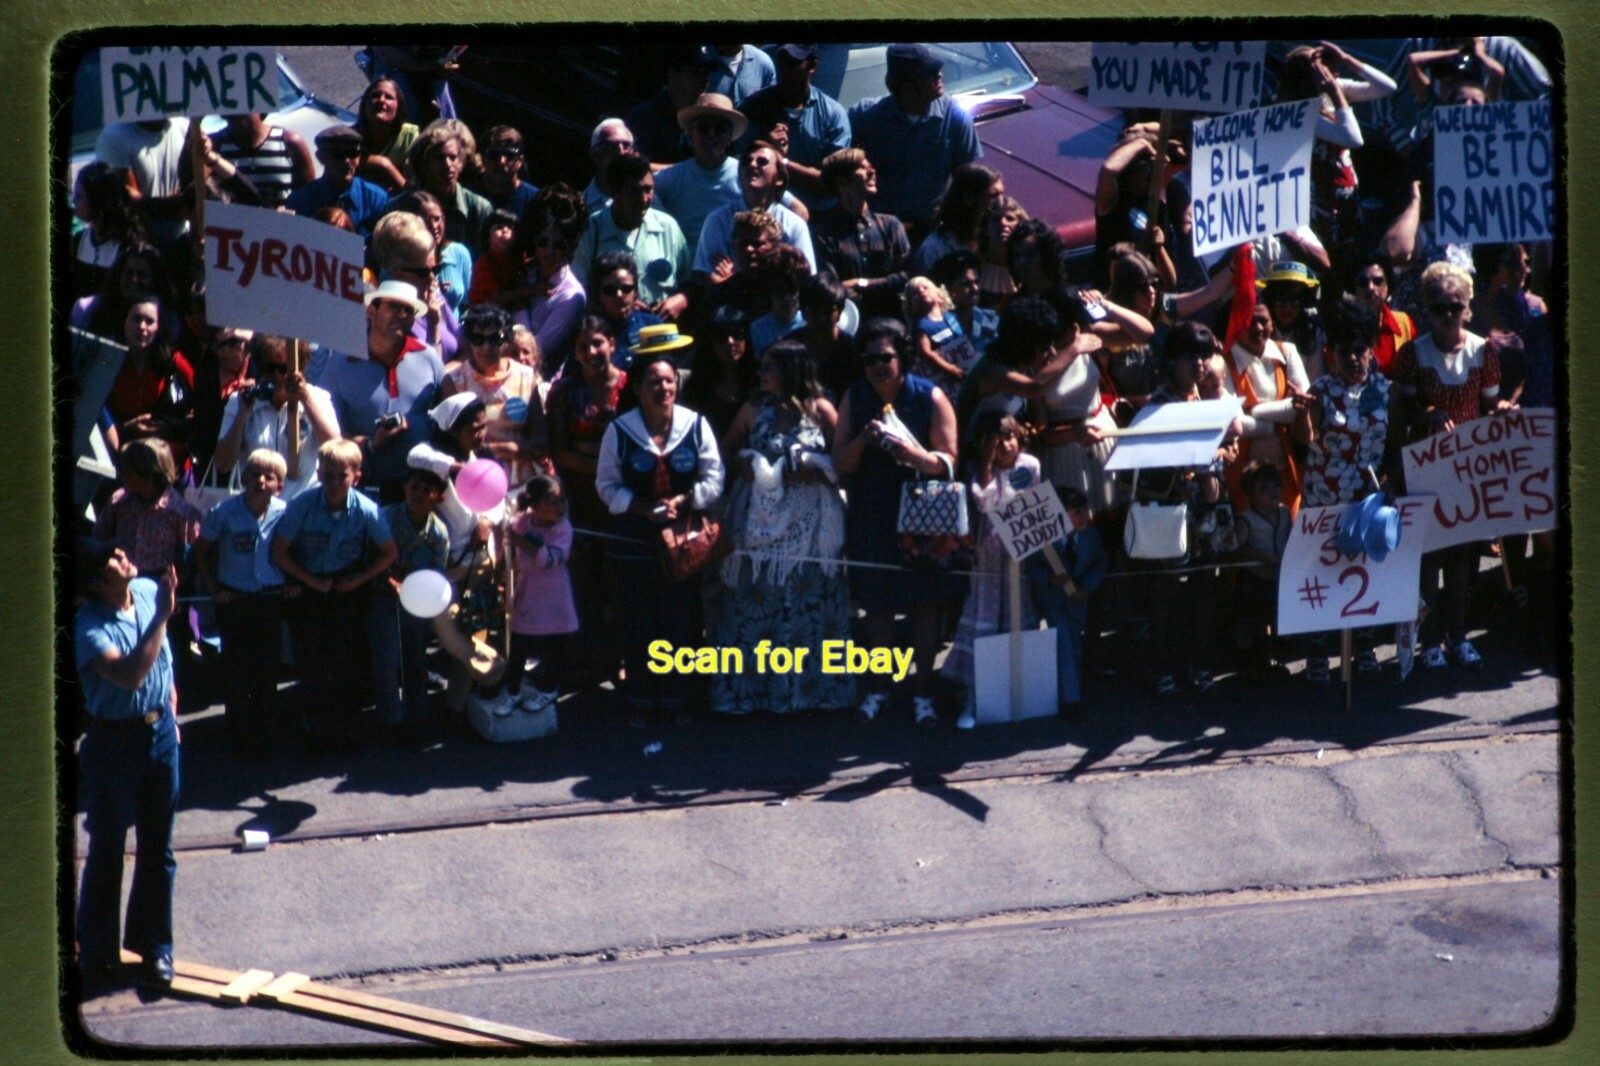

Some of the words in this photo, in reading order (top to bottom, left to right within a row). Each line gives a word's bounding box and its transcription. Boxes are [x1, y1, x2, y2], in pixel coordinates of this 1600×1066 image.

[111, 53, 277, 118] PALMER
[1090, 56, 1139, 93] YOU
[1148, 57, 1212, 101] MADE
[1222, 61, 1262, 109] IT!
[1195, 109, 1260, 149] WELCOME
[1263, 101, 1311, 133] HOME
[1435, 102, 1518, 133] WELCOME
[1211, 139, 1270, 188] BILL
[1463, 131, 1552, 180] BETO
[1193, 166, 1305, 248] BENNETT
[1410, 413, 1556, 467] WELCOME
[1453, 446, 1535, 481] HOME
[994, 491, 1050, 523] WELL
[1008, 503, 1055, 538] DONE
[1301, 502, 1423, 535] WELE
[1433, 468, 1555, 529] WES
[1015, 512, 1067, 558] DADDY!
